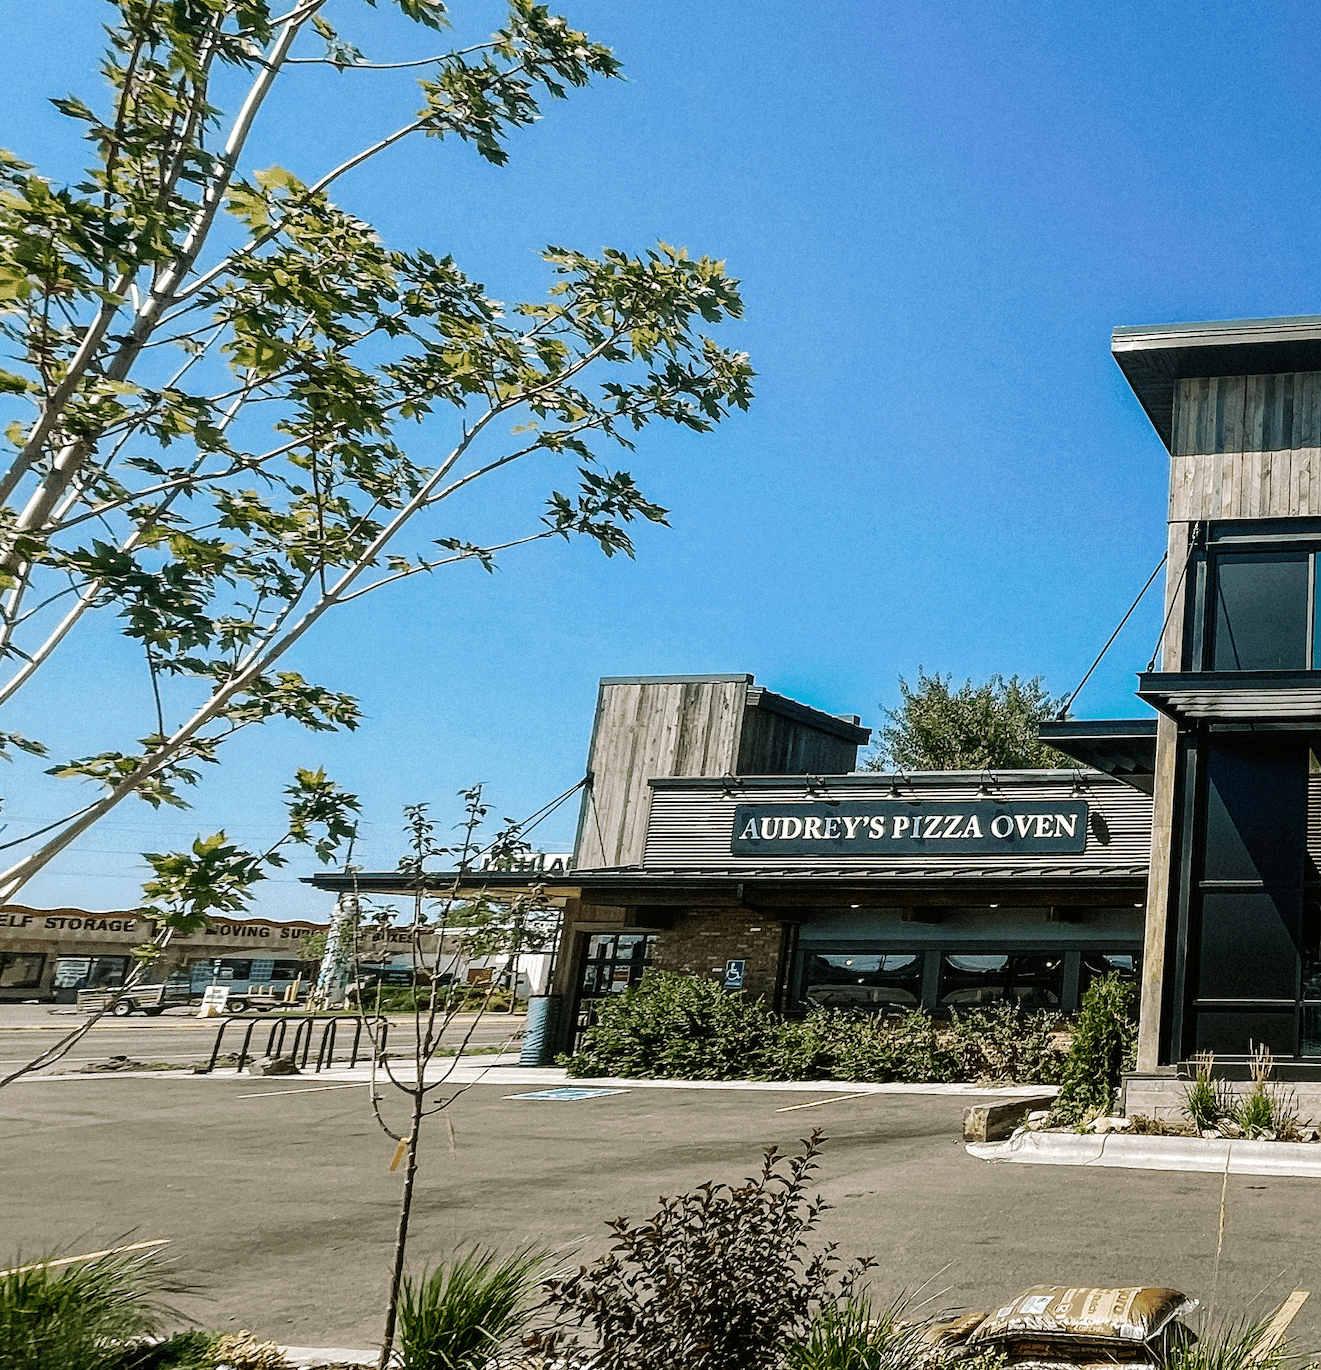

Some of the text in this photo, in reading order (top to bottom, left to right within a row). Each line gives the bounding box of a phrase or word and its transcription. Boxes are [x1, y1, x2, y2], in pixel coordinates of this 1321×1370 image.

[739, 814, 1077, 840] AUDREY'S PIZZA OVEN
[44, 917, 136, 932] STORAGE
